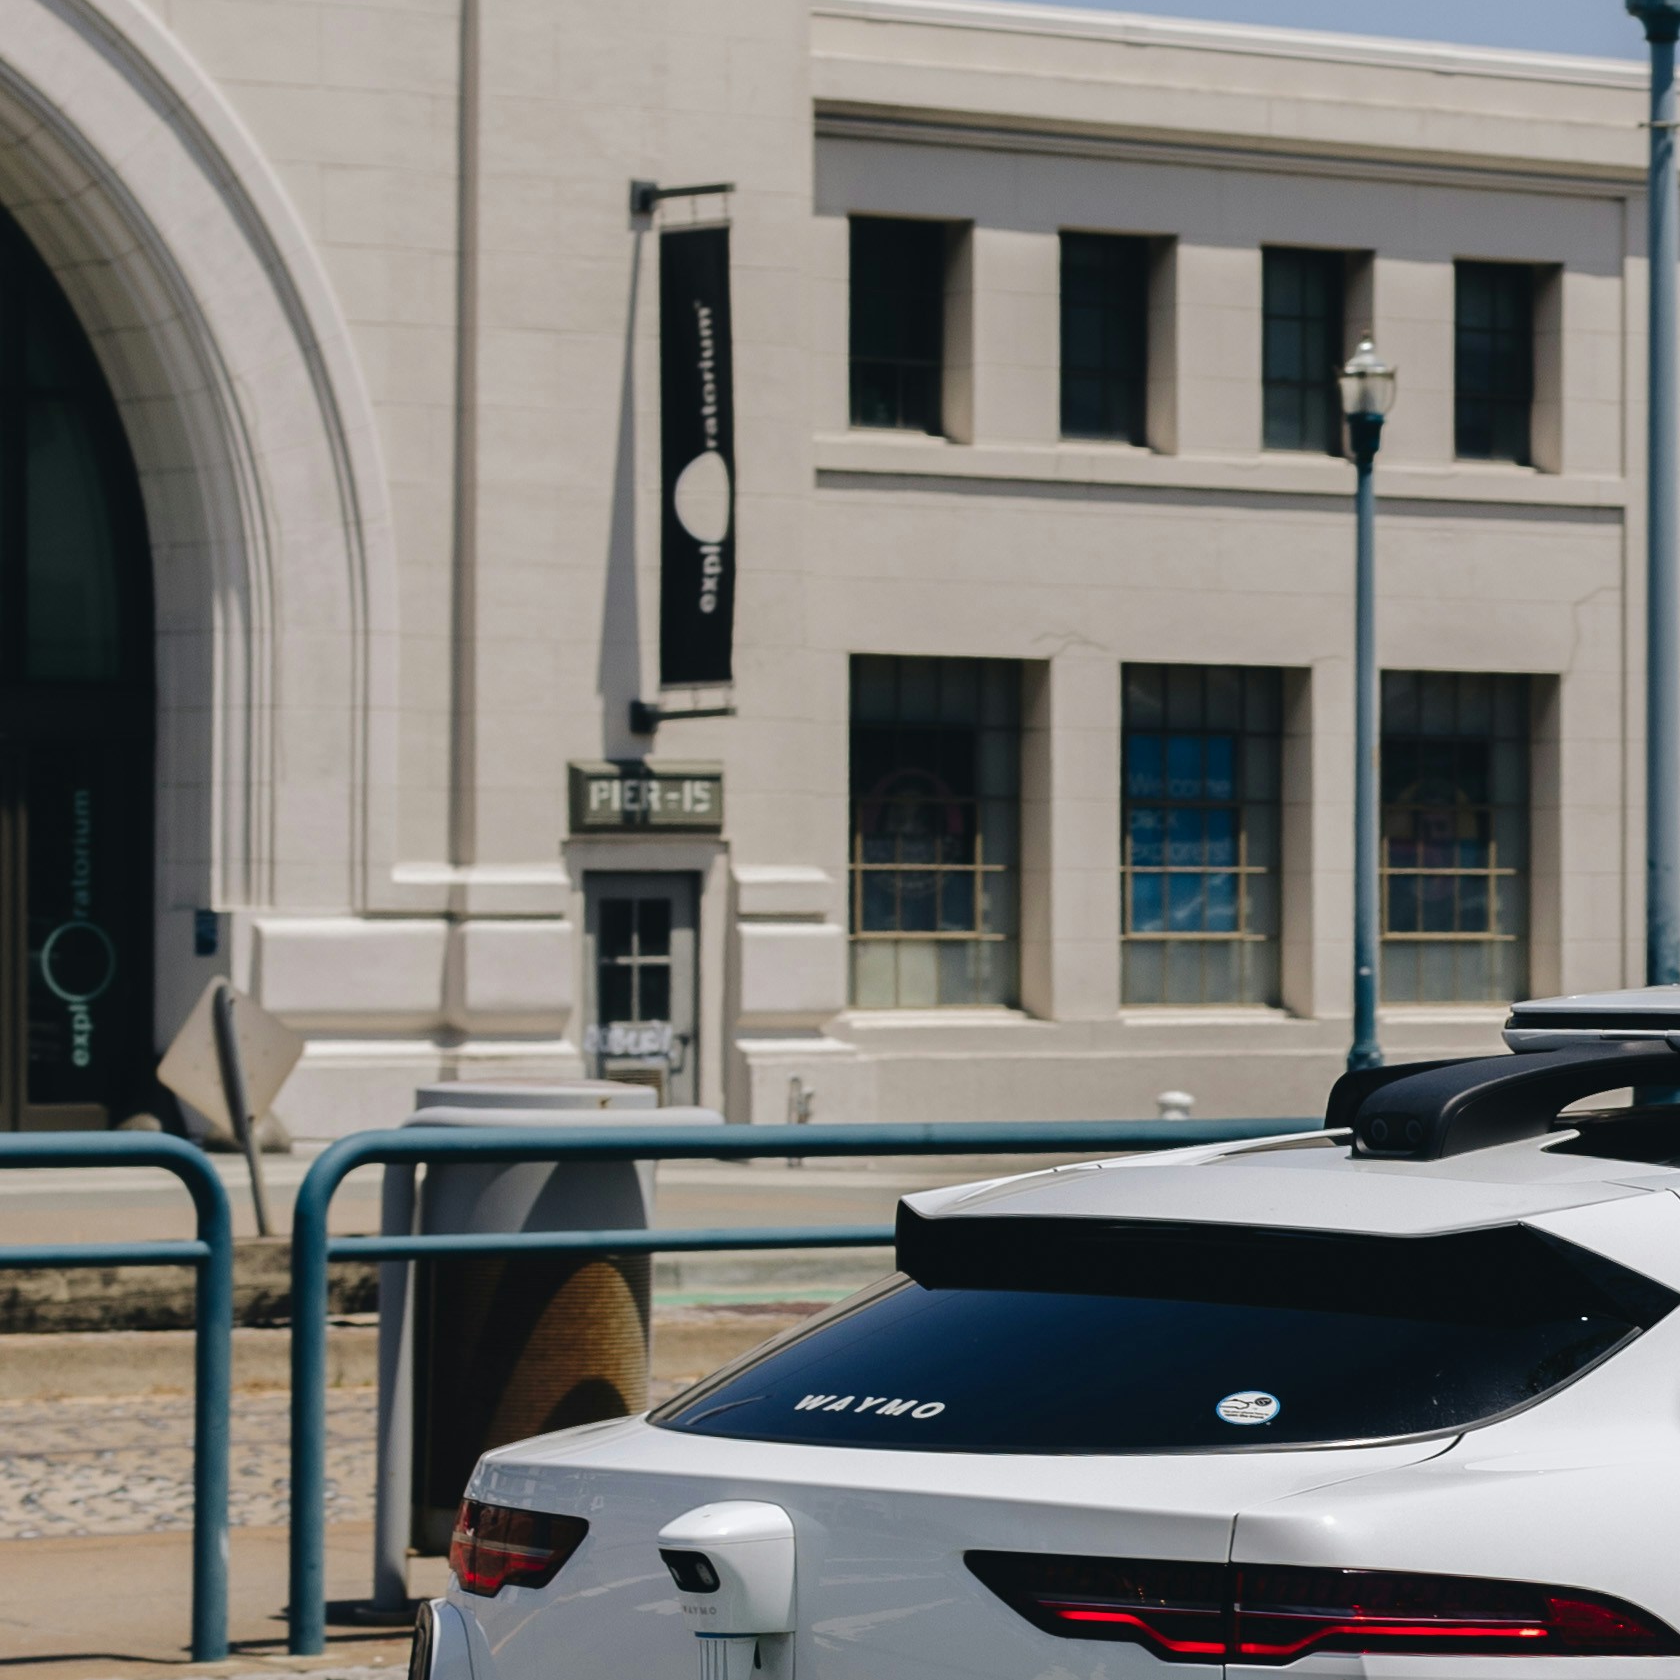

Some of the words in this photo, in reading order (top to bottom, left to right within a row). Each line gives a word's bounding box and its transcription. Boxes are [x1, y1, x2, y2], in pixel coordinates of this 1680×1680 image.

[590, 779, 711, 812] PIER-15
[1128, 772, 1231, 797] Wecome
[41, 790, 116, 1067] exploratorium
[794, 1394, 946, 1419] WAYMO
